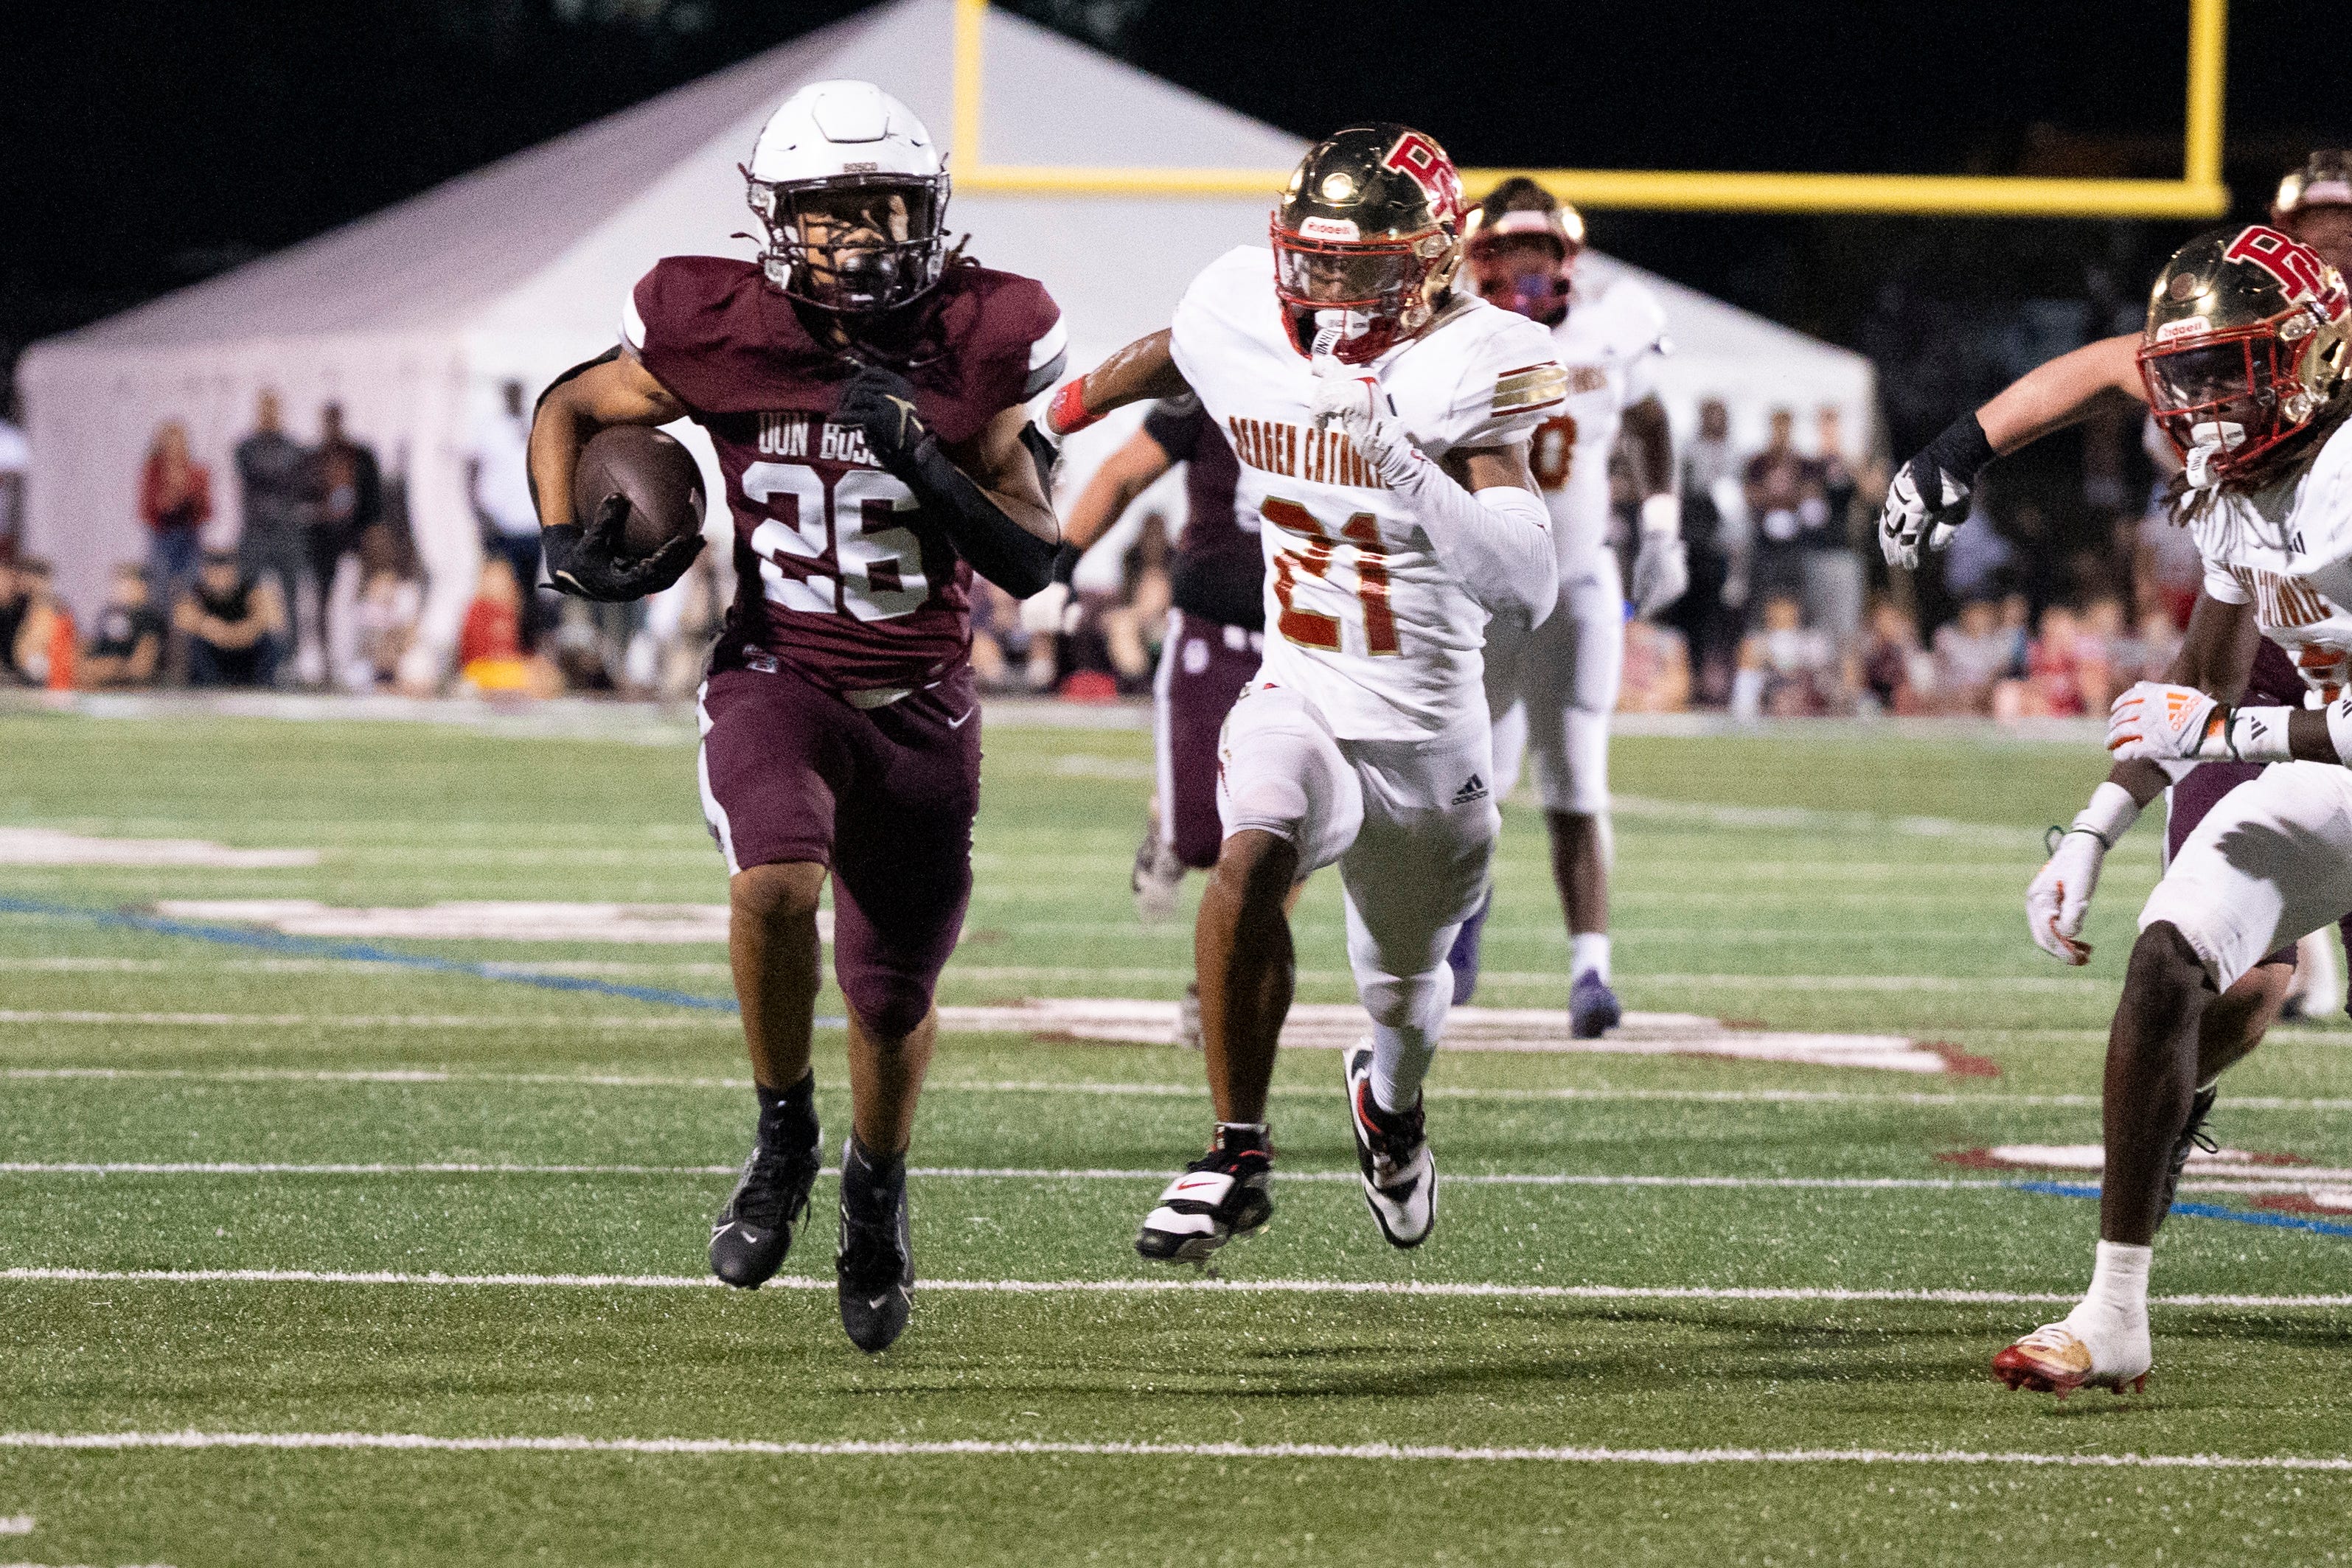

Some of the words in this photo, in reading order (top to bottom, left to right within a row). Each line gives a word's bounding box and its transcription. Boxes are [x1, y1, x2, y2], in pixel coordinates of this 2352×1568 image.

[757, 412, 809, 458] DON
[1304, 427, 1396, 490] CATHO
[741, 461, 930, 622] 26
[1259, 495, 1399, 657] 21
